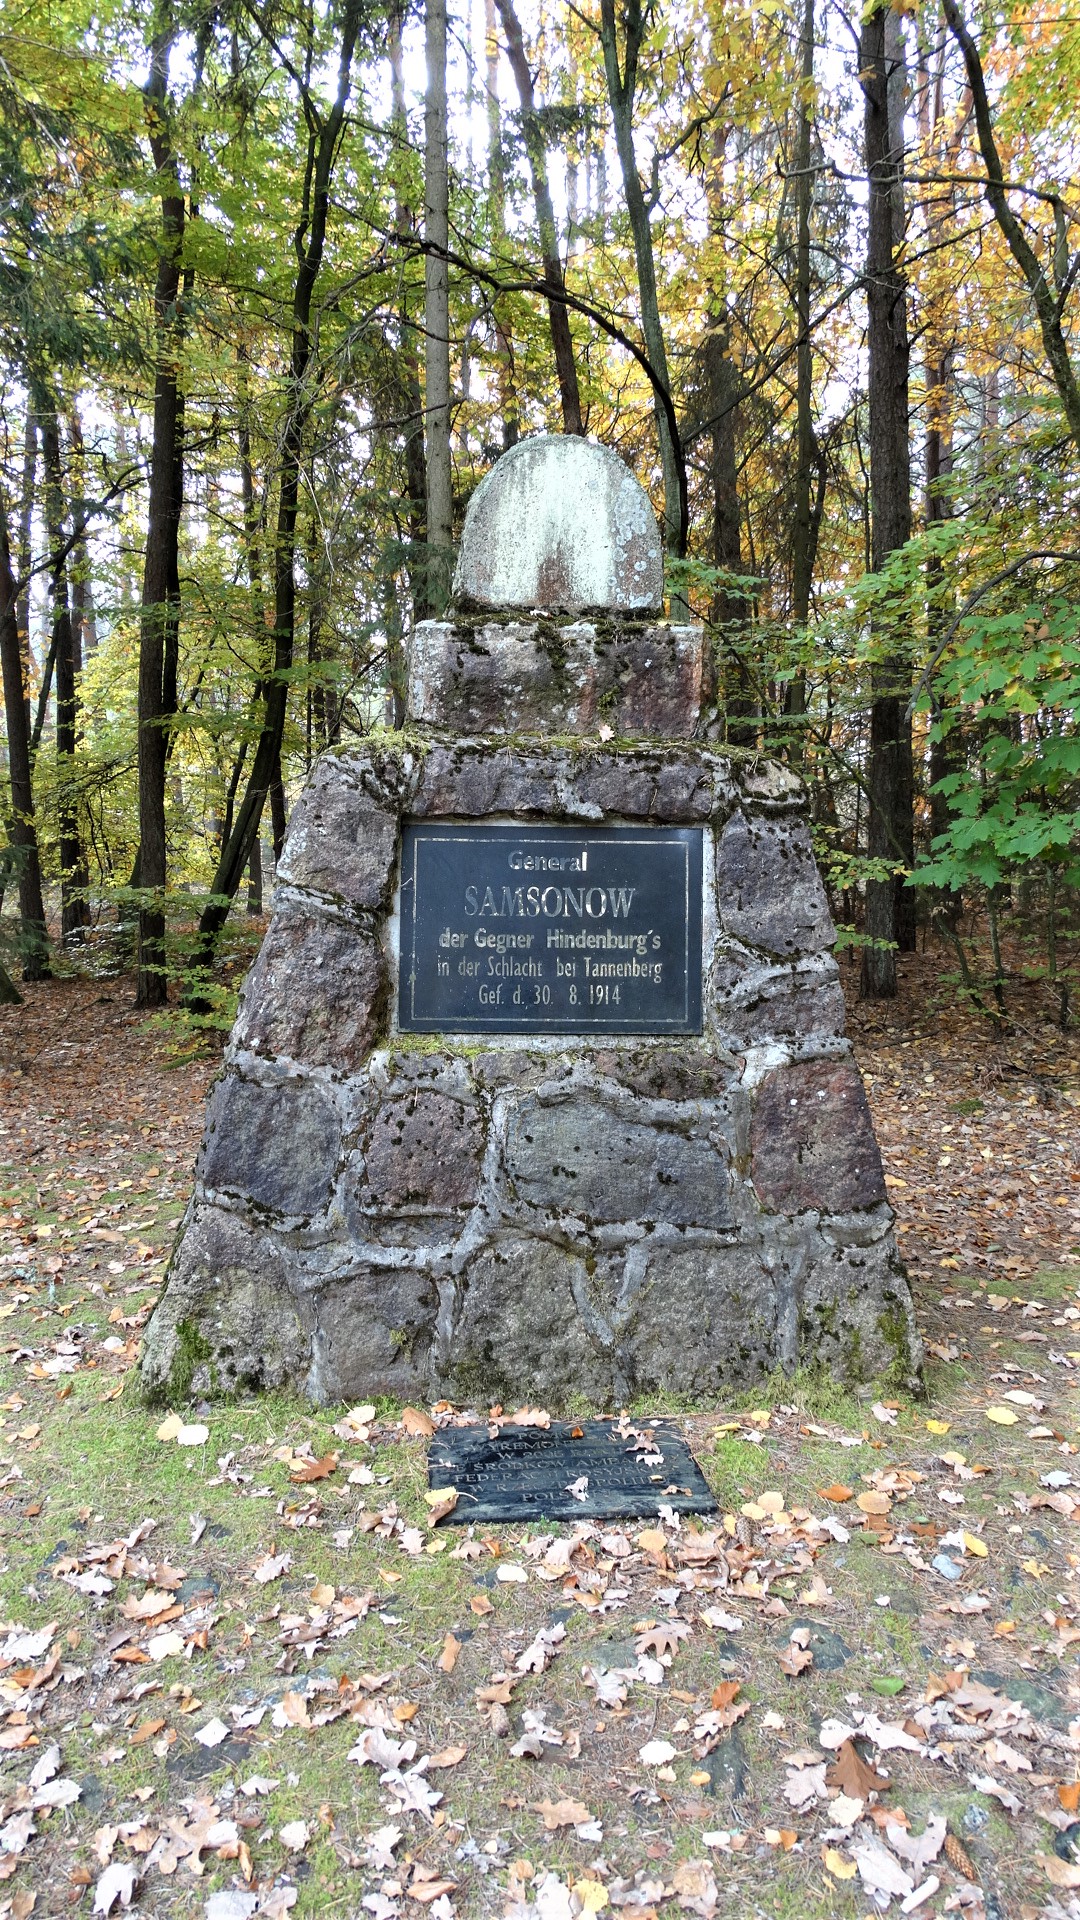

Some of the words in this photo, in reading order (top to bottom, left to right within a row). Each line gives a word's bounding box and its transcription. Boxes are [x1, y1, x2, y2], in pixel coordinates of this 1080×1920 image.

[508, 850, 588, 872] General
[464, 885, 636, 918] SAMSONOW
[438, 927, 468, 948] der
[474, 928, 535, 953] Gegner
[437, 955, 450, 977] in
[458, 956, 480, 977] der
[487, 956, 543, 978] Schlacht
[556, 957, 576, 977] bei
[583, 957, 663, 983] Tannenberg
[590, 985, 622, 1006] 1914
[497, 1451, 514, 1460] W
